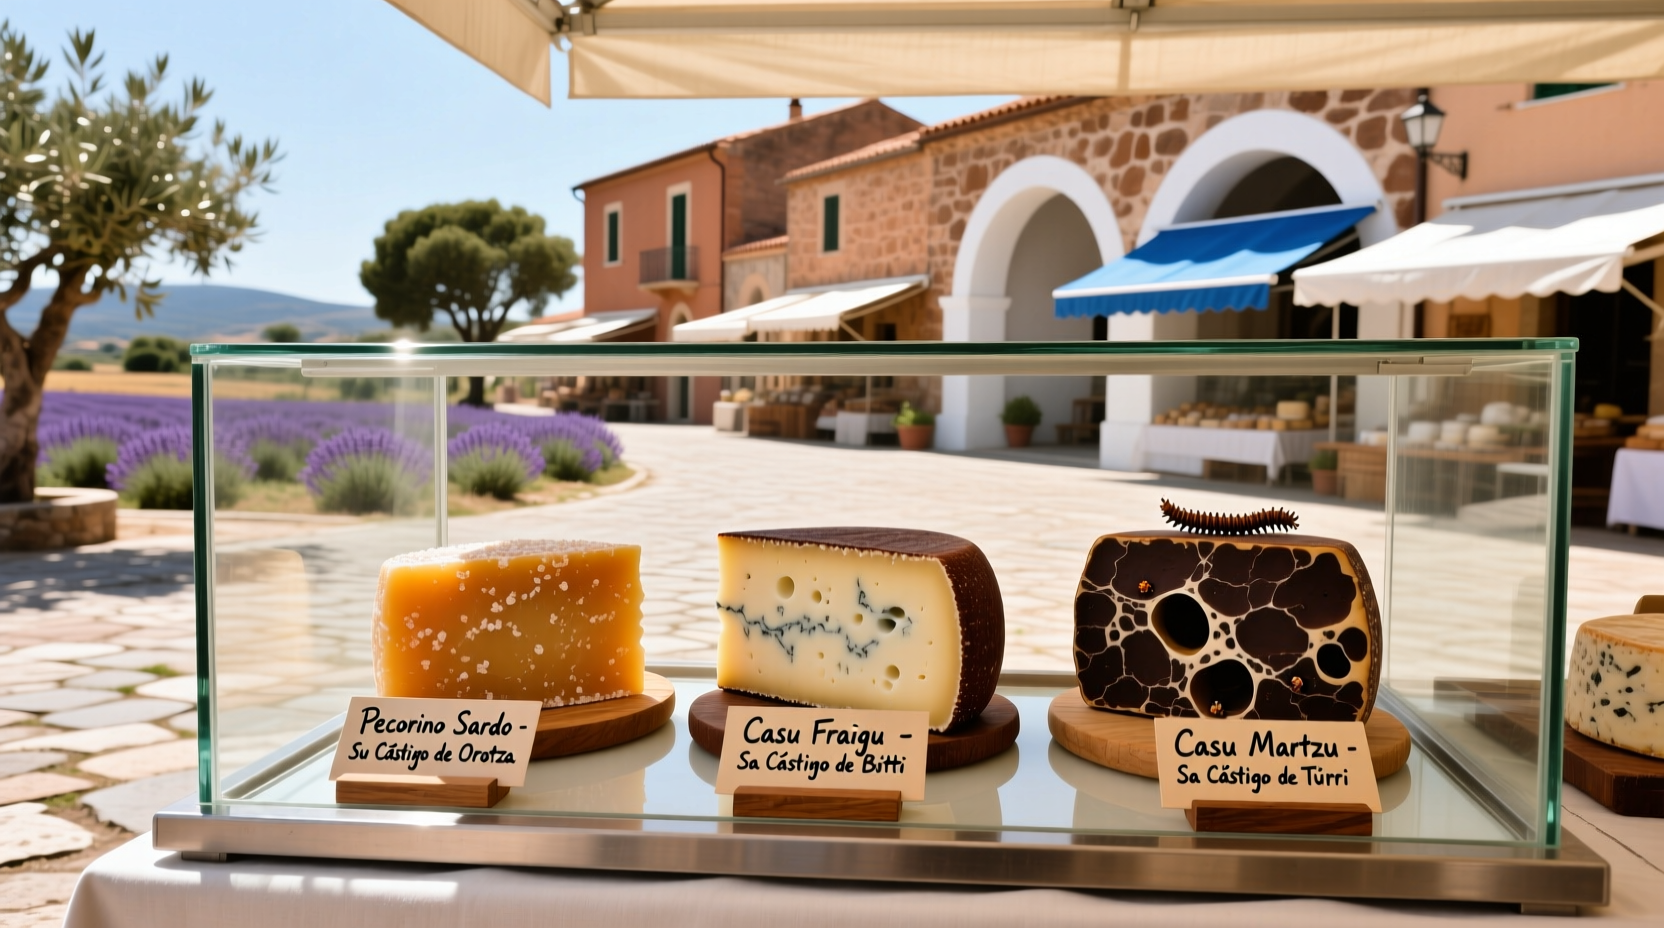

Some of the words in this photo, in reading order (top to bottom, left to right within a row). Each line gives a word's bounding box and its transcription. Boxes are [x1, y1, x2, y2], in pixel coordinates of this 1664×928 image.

[359, 705, 446, 735] Pecorino
[452, 708, 513, 737] Sardo
[743, 715, 801, 745] Casu
[811, 717, 885, 757] Fraigu
[1174, 727, 1237, 757] Casu
[1248, 728, 1339, 758] Martzu
[347, 741, 370, 761] Su
[433, 741, 453, 763] de
[458, 742, 517, 765] Orotza
[736, 750, 761, 771] Sa
[834, 752, 856, 773] de
[1176, 763, 1202, 785] Sa
[1277, 765, 1299, 786] de
